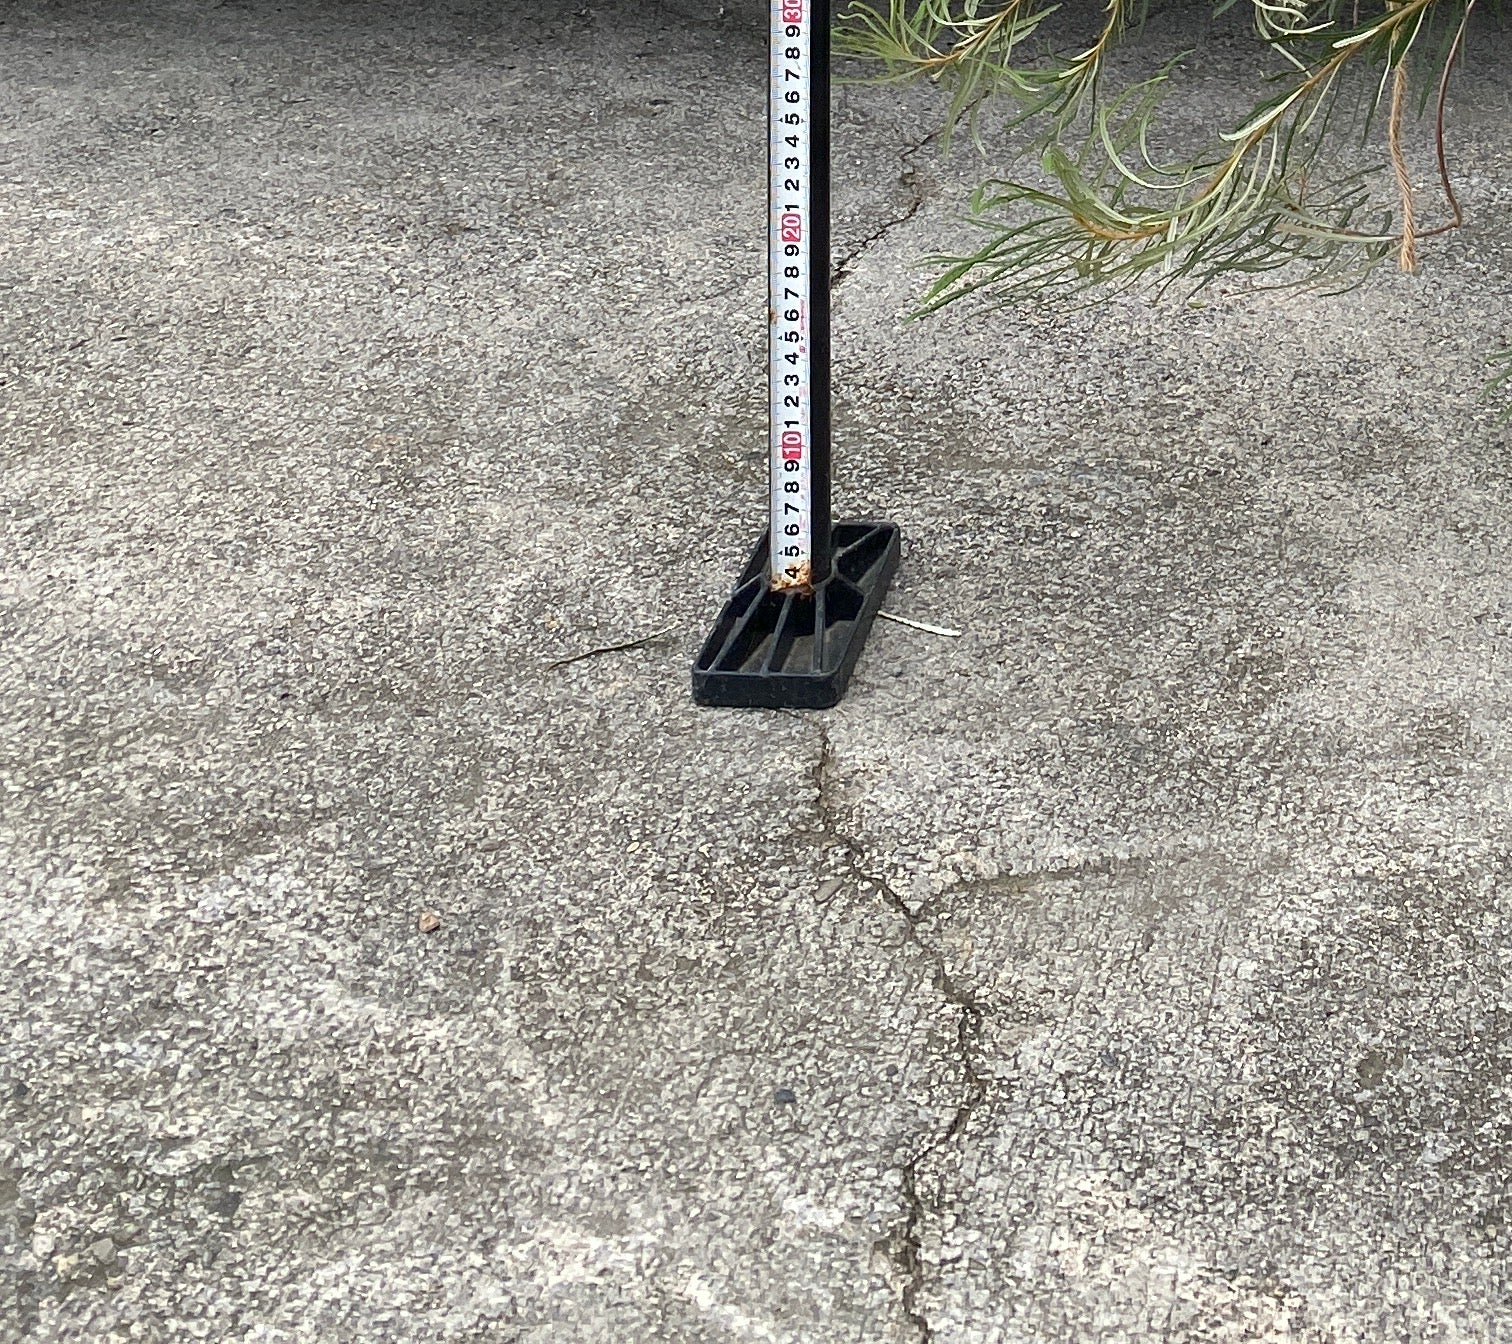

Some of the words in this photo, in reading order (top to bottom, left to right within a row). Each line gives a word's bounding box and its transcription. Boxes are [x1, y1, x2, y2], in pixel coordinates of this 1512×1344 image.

[784, 24, 800, 38] 9
[784, 46, 800, 60] 8
[784, 68, 800, 82] 7
[784, 90, 800, 104] 6
[784, 113, 800, 127] 5
[784, 134, 800, 148] 4
[784, 156, 800, 170] 3
[784, 178, 800, 192] 2
[784, 204, 800, 213] 1
[783, 215, 801, 241] 20
[783, 244, 799, 258] 9
[783, 265, 799, 279] 8
[784, 287, 800, 301] 7
[783, 308, 799, 322] 6
[783, 330, 799, 344] 5
[784, 352, 800, 366] 4
[783, 374, 799, 388] 3
[783, 395, 799, 409] 2
[783, 420, 799, 429] 1
[783, 434, 802, 458] 10
[784, 459, 800, 473] 9
[784, 480, 800, 494] 8
[784, 502, 800, 516] 7
[784, 523, 800, 537] 6
[784, 545, 800, 559] 5
[785, 567, 800, 580] 4
